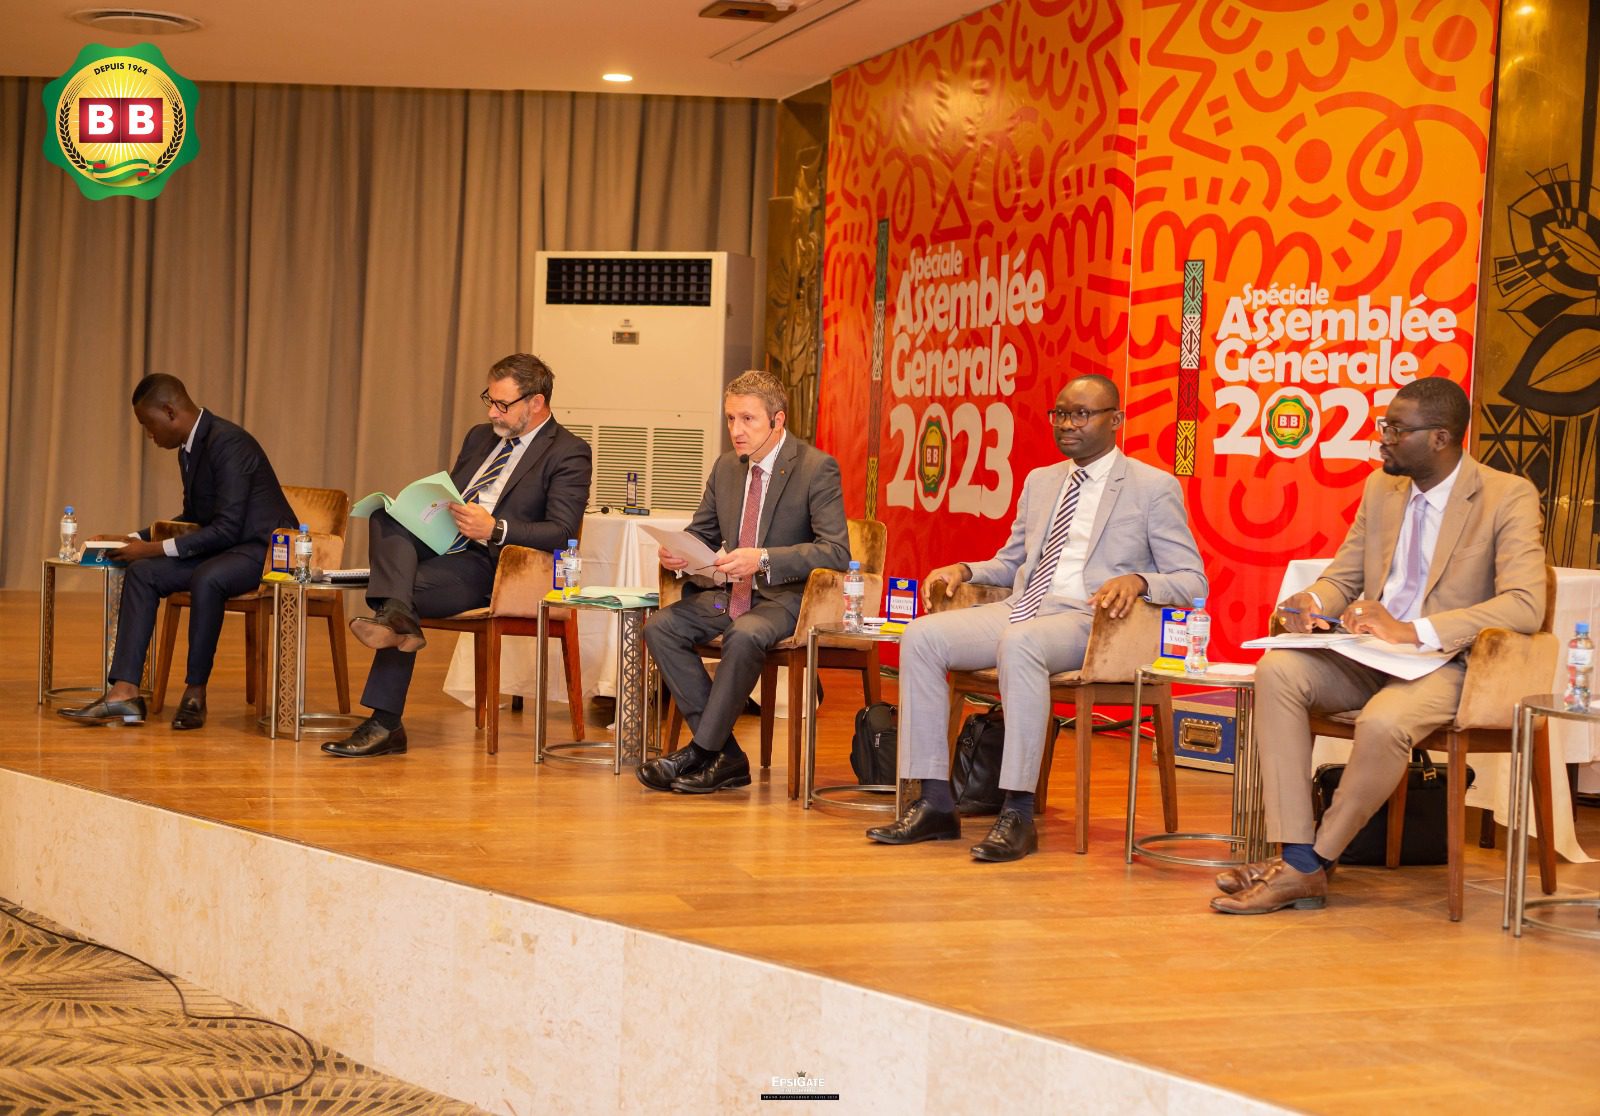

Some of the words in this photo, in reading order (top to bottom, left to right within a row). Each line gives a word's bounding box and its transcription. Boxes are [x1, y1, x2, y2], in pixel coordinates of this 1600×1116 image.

[909, 241, 963, 287] Spéciale
[892, 248, 1046, 337] Assemblée
[1242, 282, 1329, 310] Spéciale
[1216, 293, 1458, 343] Assemblée
[890, 324, 1018, 398] Générale
[1214, 337, 1419, 386] Générale
[886, 402, 1015, 520] 2023
